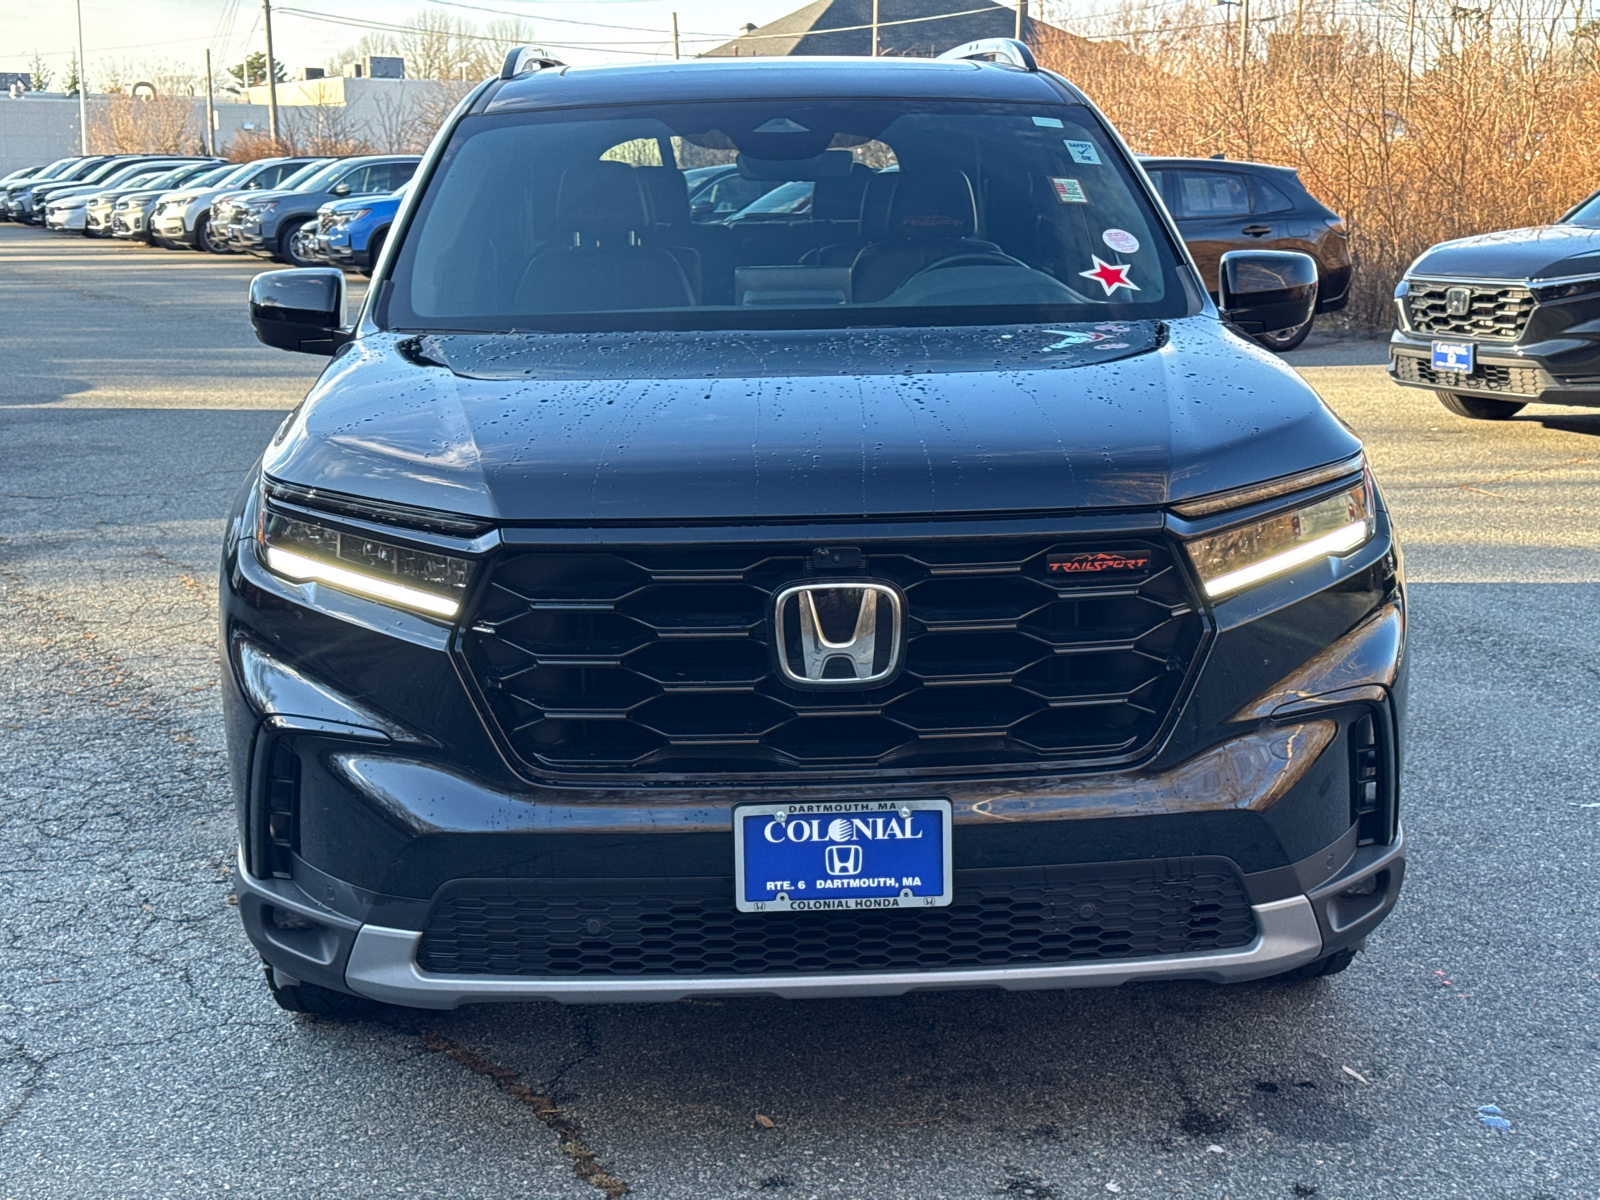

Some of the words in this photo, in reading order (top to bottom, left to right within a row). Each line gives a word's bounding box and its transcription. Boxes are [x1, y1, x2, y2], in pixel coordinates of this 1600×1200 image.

[1049, 558, 1148, 573] TRAILSPORT
[878, 802, 897, 810] MA
[764, 817, 923, 843] COLONIAL
[766, 881, 795, 891] RTE.
[797, 880, 806, 890] 6
[816, 878, 899, 889] DARTMOUTH,
[902, 877, 922, 886] MA
[790, 900, 851, 910] COLONIAL
[855, 898, 900, 908] HONDA
